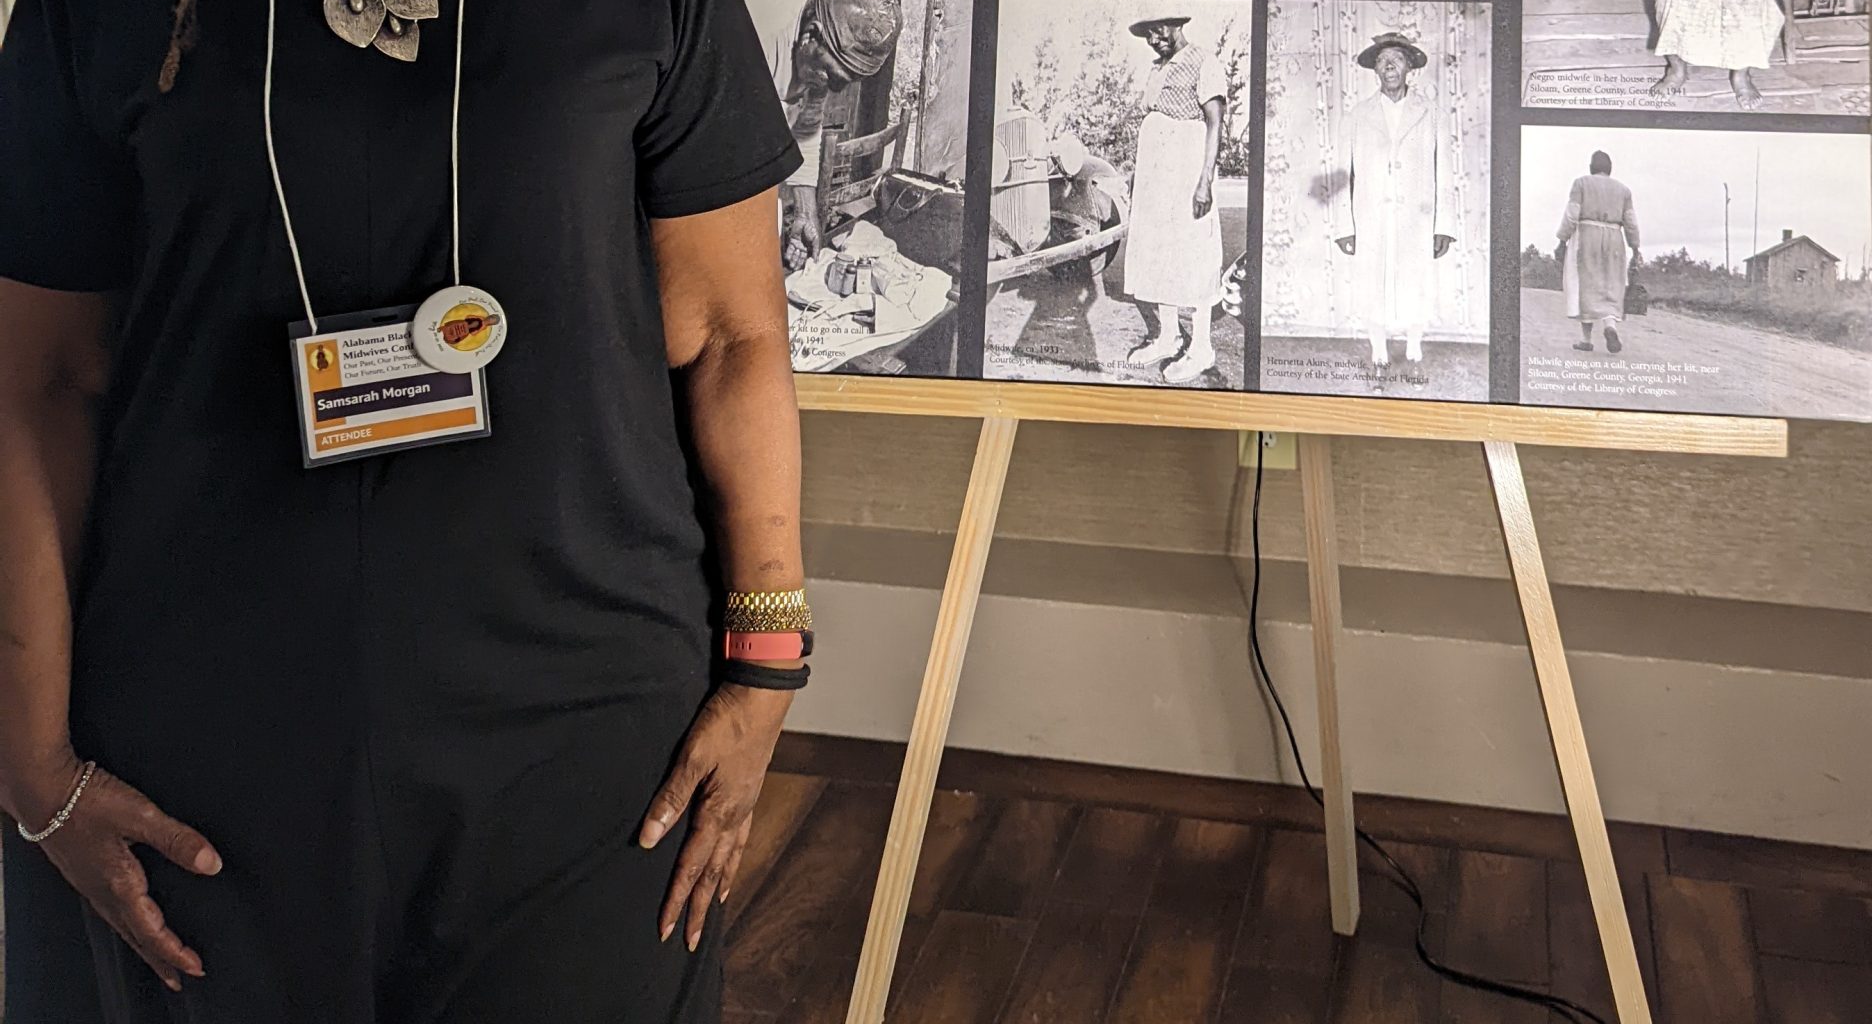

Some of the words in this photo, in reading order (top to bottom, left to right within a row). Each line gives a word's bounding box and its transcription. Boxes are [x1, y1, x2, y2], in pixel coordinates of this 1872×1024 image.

[1530, 73, 1554, 83] Negro
[1558, 74, 1590, 82] midwife
[1604, 74, 1618, 82] her
[1620, 74, 1644, 82] house
[1530, 84, 1560, 93] Siloam,
[1562, 85, 1592, 93] Greene
[1594, 86, 1626, 96] County,
[1530, 96, 1566, 106] Courtesy
[1596, 98, 1624, 108] Library
[1627, 98, 1637, 106] of
[1638, 99, 1676, 108] Congress
[820, 327, 830, 335] go
[851, 326, 864, 334] call
[342, 337, 385, 348] Alabama
[806, 336, 824, 344] 1941
[343, 348, 389, 360] Midwives
[811, 348, 846, 358] Congress
[1117, 360, 1146, 370] Florida
[1266, 357, 1304, 366] Henrietta
[1528, 356, 1562, 366] Midwife
[1564, 360, 1588, 369] going
[1611, 360, 1628, 370] call,
[1630, 362, 1665, 373] carrying
[1667, 362, 1682, 372] her
[1684, 363, 1698, 373] kit,
[361, 368, 386, 377] Future,
[1266, 369, 1301, 380] Courtesy
[1304, 370, 1315, 378] of
[1316, 370, 1328, 379] the
[1330, 372, 1350, 380] State
[1389, 374, 1398, 382] of
[1528, 368, 1559, 379] Siloam,
[1562, 370, 1592, 380] Greene
[1594, 372, 1626, 383] County,
[1628, 372, 1663, 384] Georgia,
[1667, 374, 1687, 384] 1941
[1528, 381, 1564, 392] Courtesy
[1567, 382, 1578, 391] of
[1578, 382, 1592, 392] the
[1594, 384, 1624, 396] Library
[1627, 385, 1637, 394] of
[1638, 385, 1677, 396] Congress
[317, 391, 379, 411] Samsarah
[382, 384, 431, 400] Morgan
[322, 428, 372, 446] ATTENDEE
